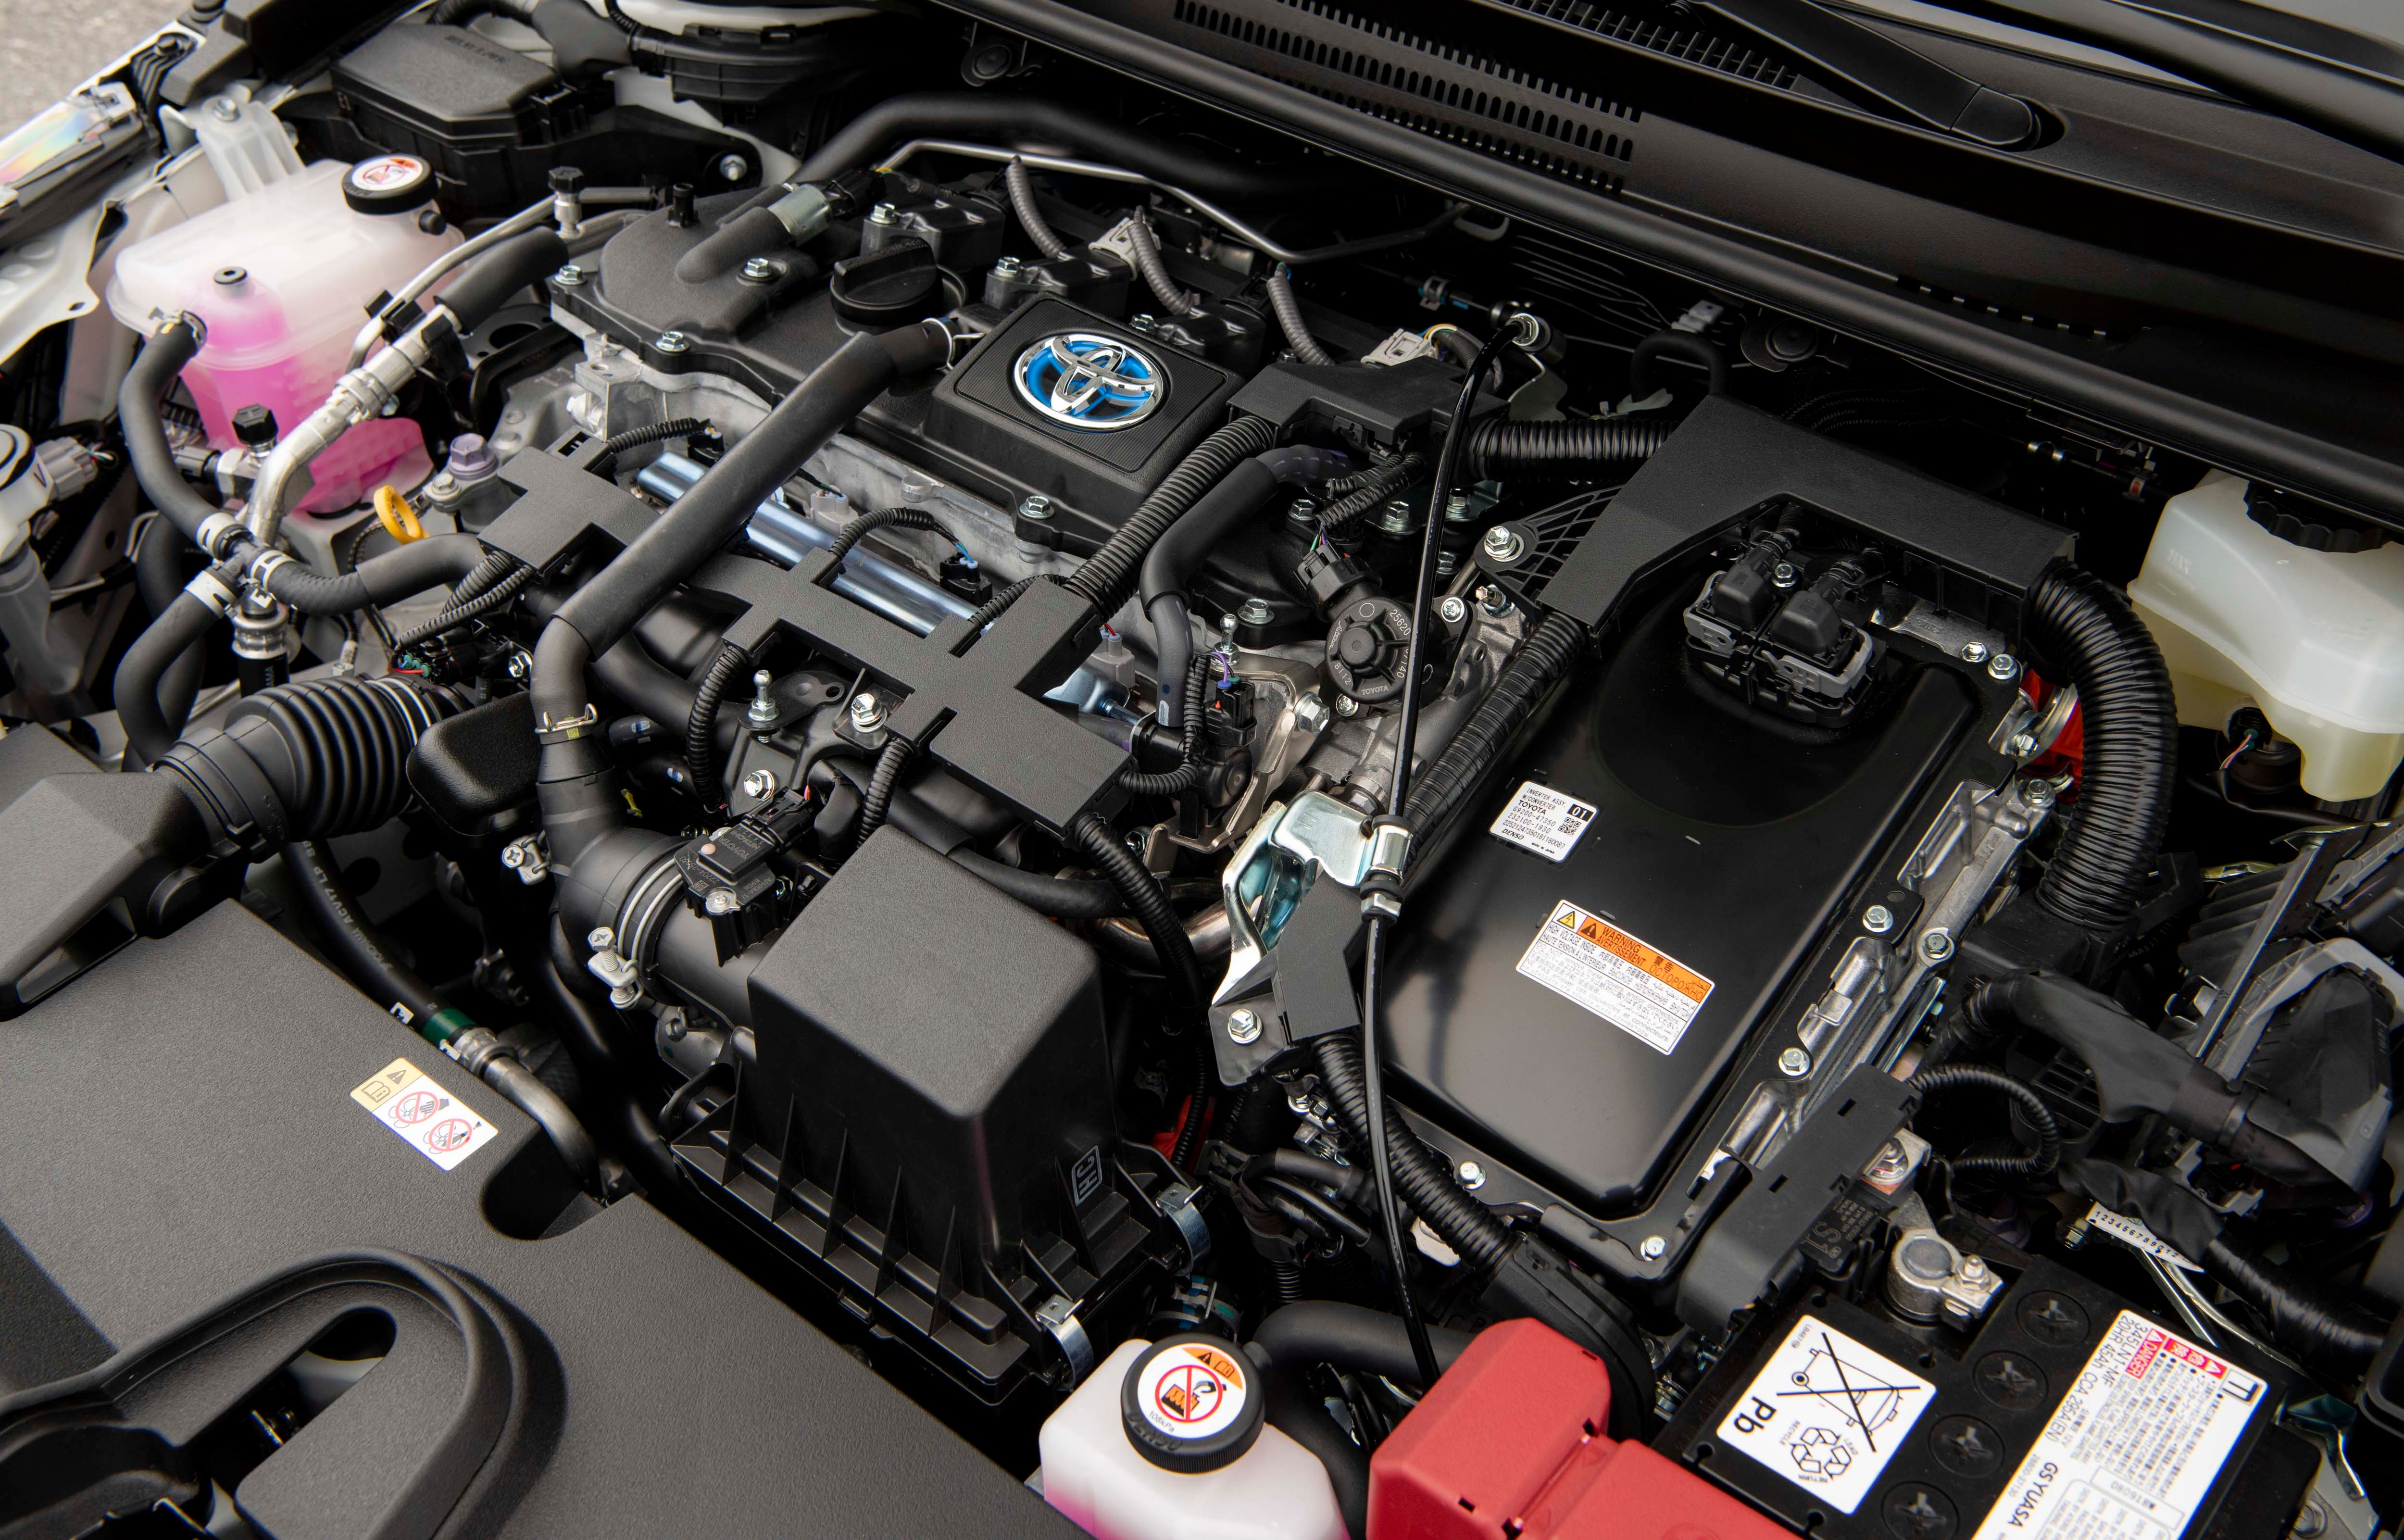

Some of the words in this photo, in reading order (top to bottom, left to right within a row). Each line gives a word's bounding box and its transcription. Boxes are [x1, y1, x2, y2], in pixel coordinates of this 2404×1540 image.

[1390, 609, 1411, 635] 25620
[1334, 663, 1351, 685] 8112
[1361, 685, 1389, 695] TOYOTA
[1518, 800, 1545, 815] TOYOTA
[1522, 794, 1556, 810] W/CONVERTER
[1526, 788, 1551, 801] INVERTER
[1507, 813, 1551, 834] 232100-1930
[1513, 806, 1556, 826] G9200-47350
[1572, 806, 1587, 819] 01
[718, 835, 749, 858] TOYOTA
[730, 829, 760, 850] HITACHI
[1502, 828, 1524, 839] DENSO
[312, 865, 328, 884] LP
[324, 886, 354, 925] ACV17
[1541, 931, 1558, 945] HAUTE
[1555, 939, 1577, 955] TENSION
[1547, 922, 1561, 935] HIGH
[1559, 928, 1581, 946] VOLTAGE
[1579, 939, 1597, 954] INSIDE
[1595, 935, 1646, 967] AVERTISSEMENT
[1601, 927, 1641, 953] WARNING
[1536, 941, 1547, 951] DO
[1548, 948, 1562, 959] NOT
[1563, 956, 1584, 971] remove
[1587, 968, 1603, 981] these
[1604, 978, 1623, 992] covers
[1626, 990, 1645, 1004] and/or
[1653, 955, 1675, 973] 警告
[1526, 958, 1536, 966] NE
[1537, 964, 1551, 975] PAS
[1552, 972, 1575, 988] enlever
[1576, 985, 1587, 994] ces
[1588, 992, 1622, 1014] couvercles
[1648, 964, 1704, 1001] ОСТОРОЖНО
[2108, 1315, 2134, 1345] 20HR
[2091, 1341, 2117, 1371] 45Ah
[2101, 1322, 2147, 1388] 345LN1-MF
[2127, 1340, 2157, 1377] DANGER
[2074, 1370, 2098, 1397] CCA
[1730, 1393, 1778, 1442] Pb
[2044, 1394, 2083, 1444] 295A(EN)
[2038, 1460, 2059, 1483] GS
[2007, 1481, 2046, 1528] YUASA
